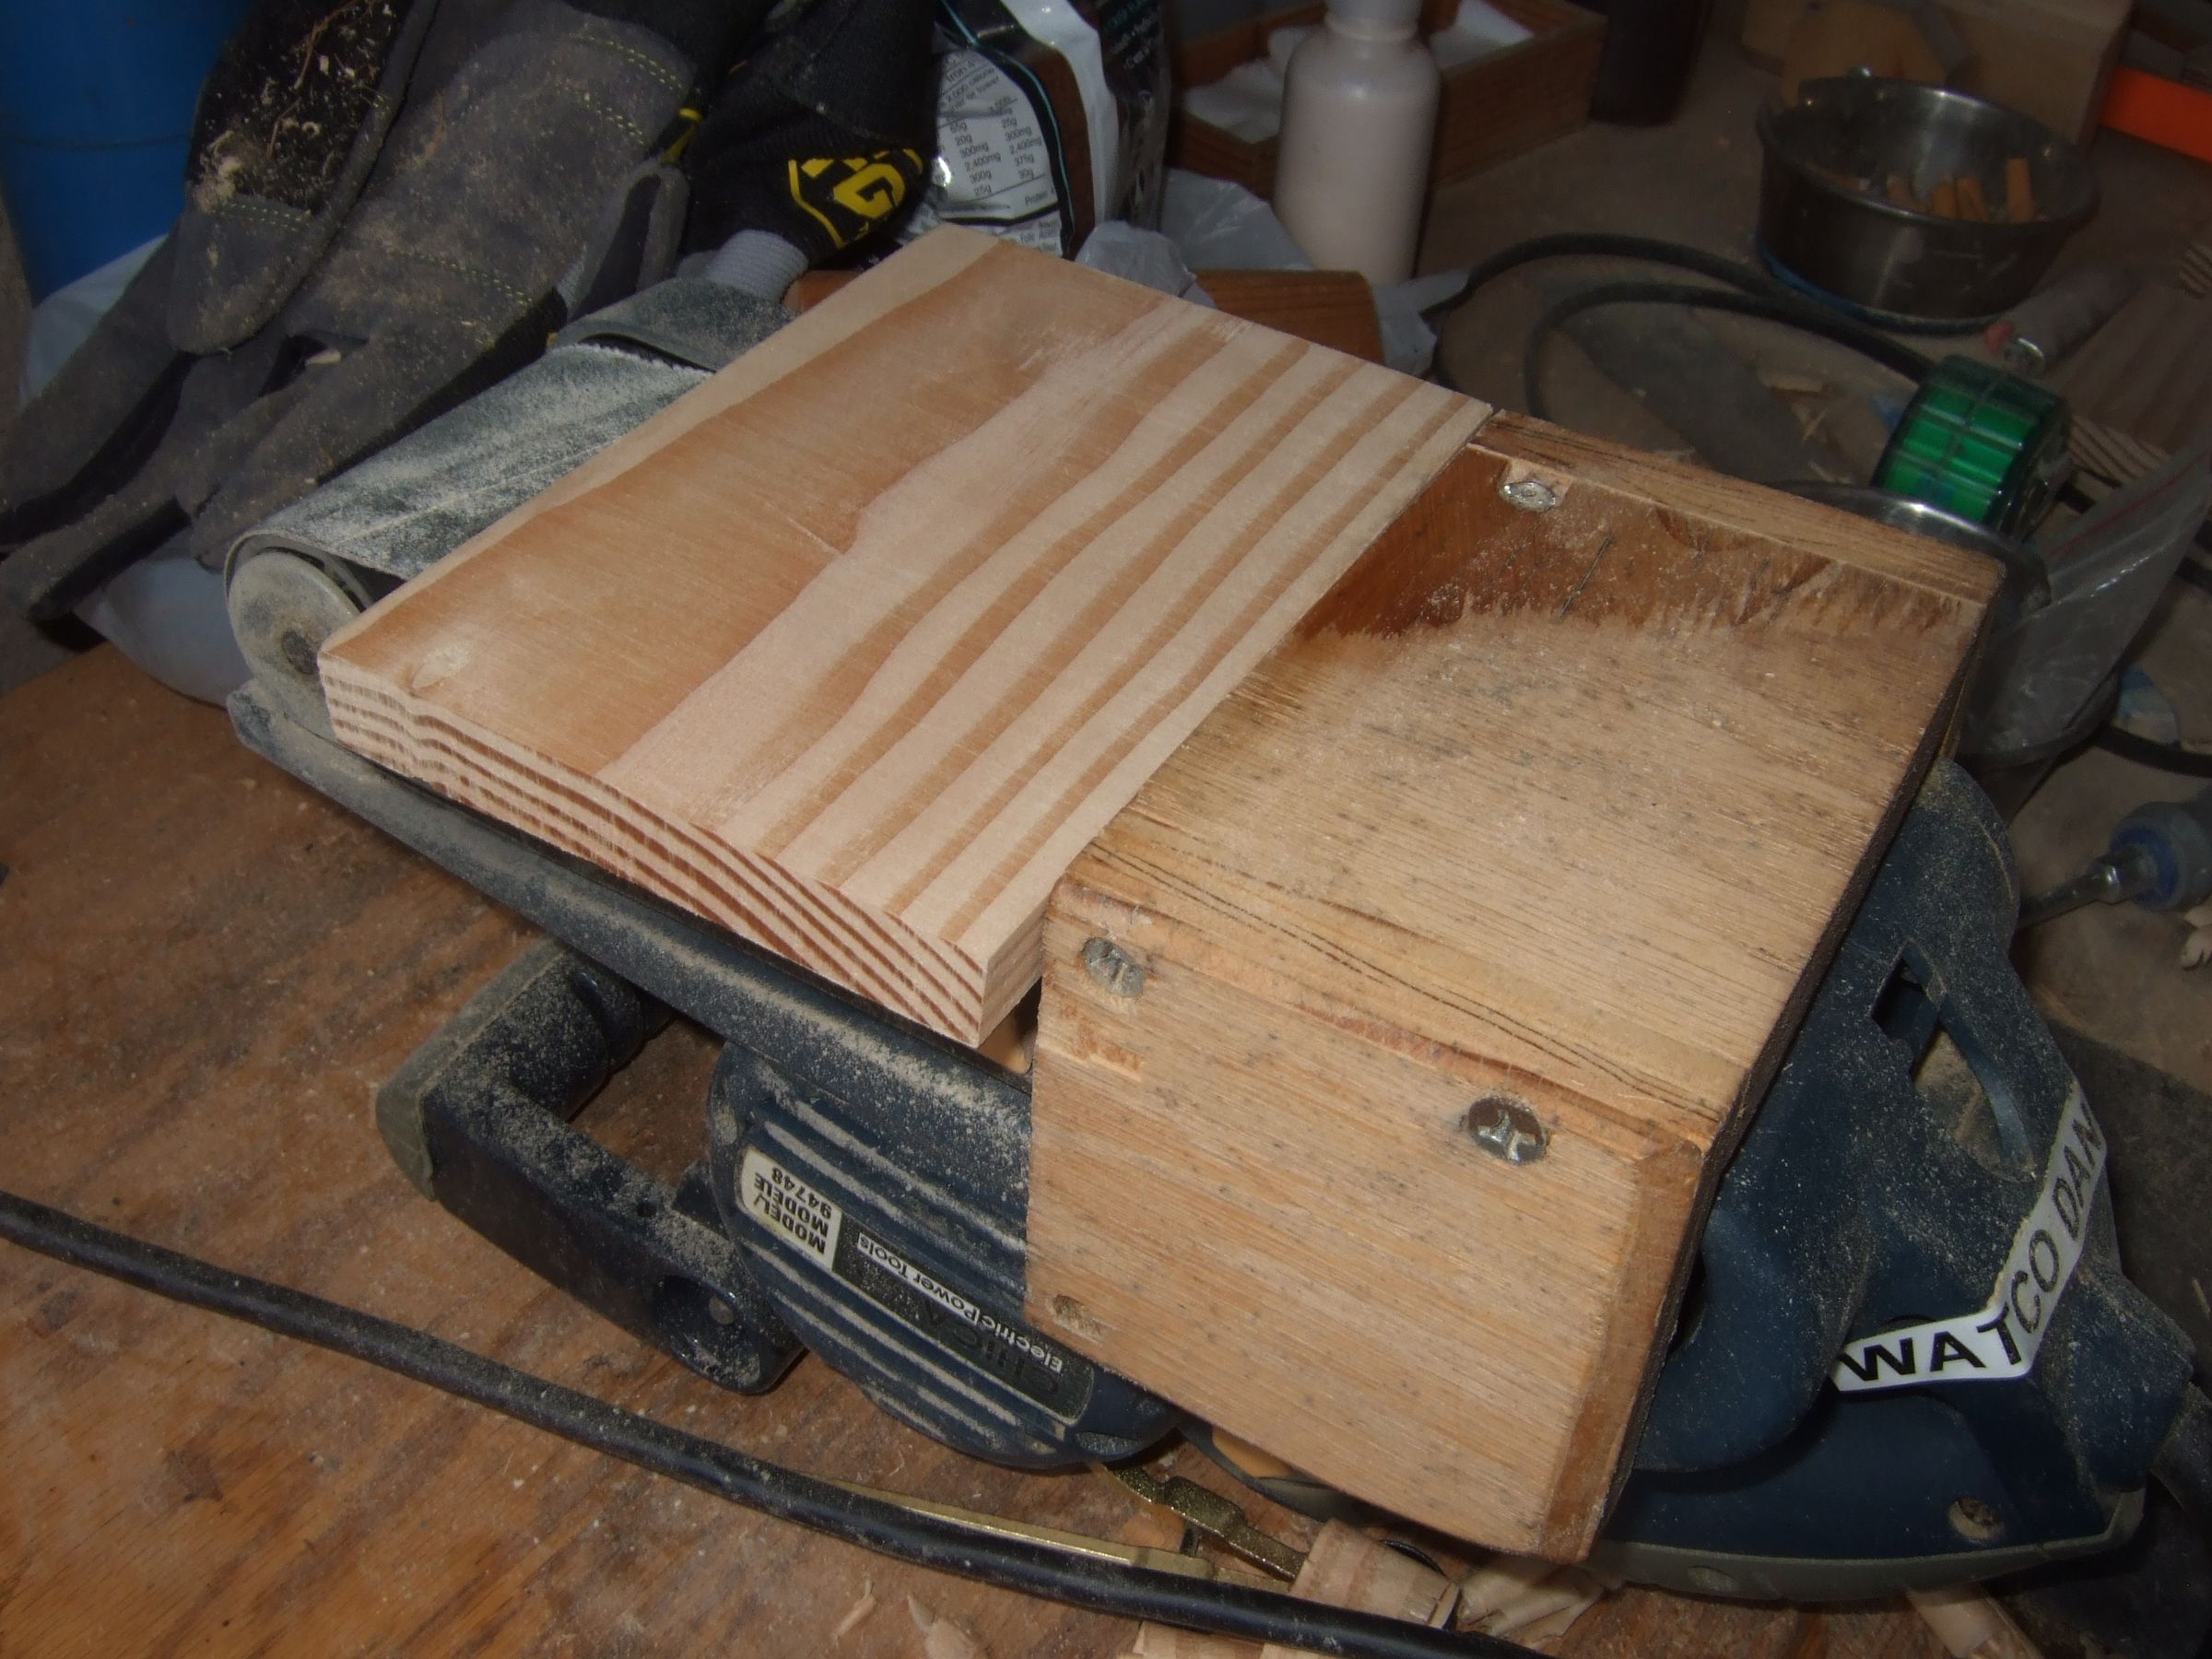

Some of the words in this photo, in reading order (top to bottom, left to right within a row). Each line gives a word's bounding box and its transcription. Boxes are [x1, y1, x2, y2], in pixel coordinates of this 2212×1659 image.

[949, 122, 968, 134] 65g
[955, 135, 972, 146] 20g
[1001, 117, 1018, 129] 25g
[959, 142, 989, 158] 300mg
[1005, 126, 1032, 142] 300mg
[964, 152, 1001, 171] 2,400mg
[1009, 136, 1042, 155] 2,400mg
[970, 170, 993, 183] 300g
[1015, 154, 1035, 167] 375g
[974, 184, 993, 196] 25g
[754, 1172, 829, 1239] MODELE
[771, 1167, 831, 1218] 94748
[753, 1193, 826, 1254] MODEL/
[859, 1235, 910, 1278] Tools
[913, 1271, 978, 1322] Power
[1838, 1230, 2059, 1382] WATCO
[980, 1315, 1064, 1373] Electric
